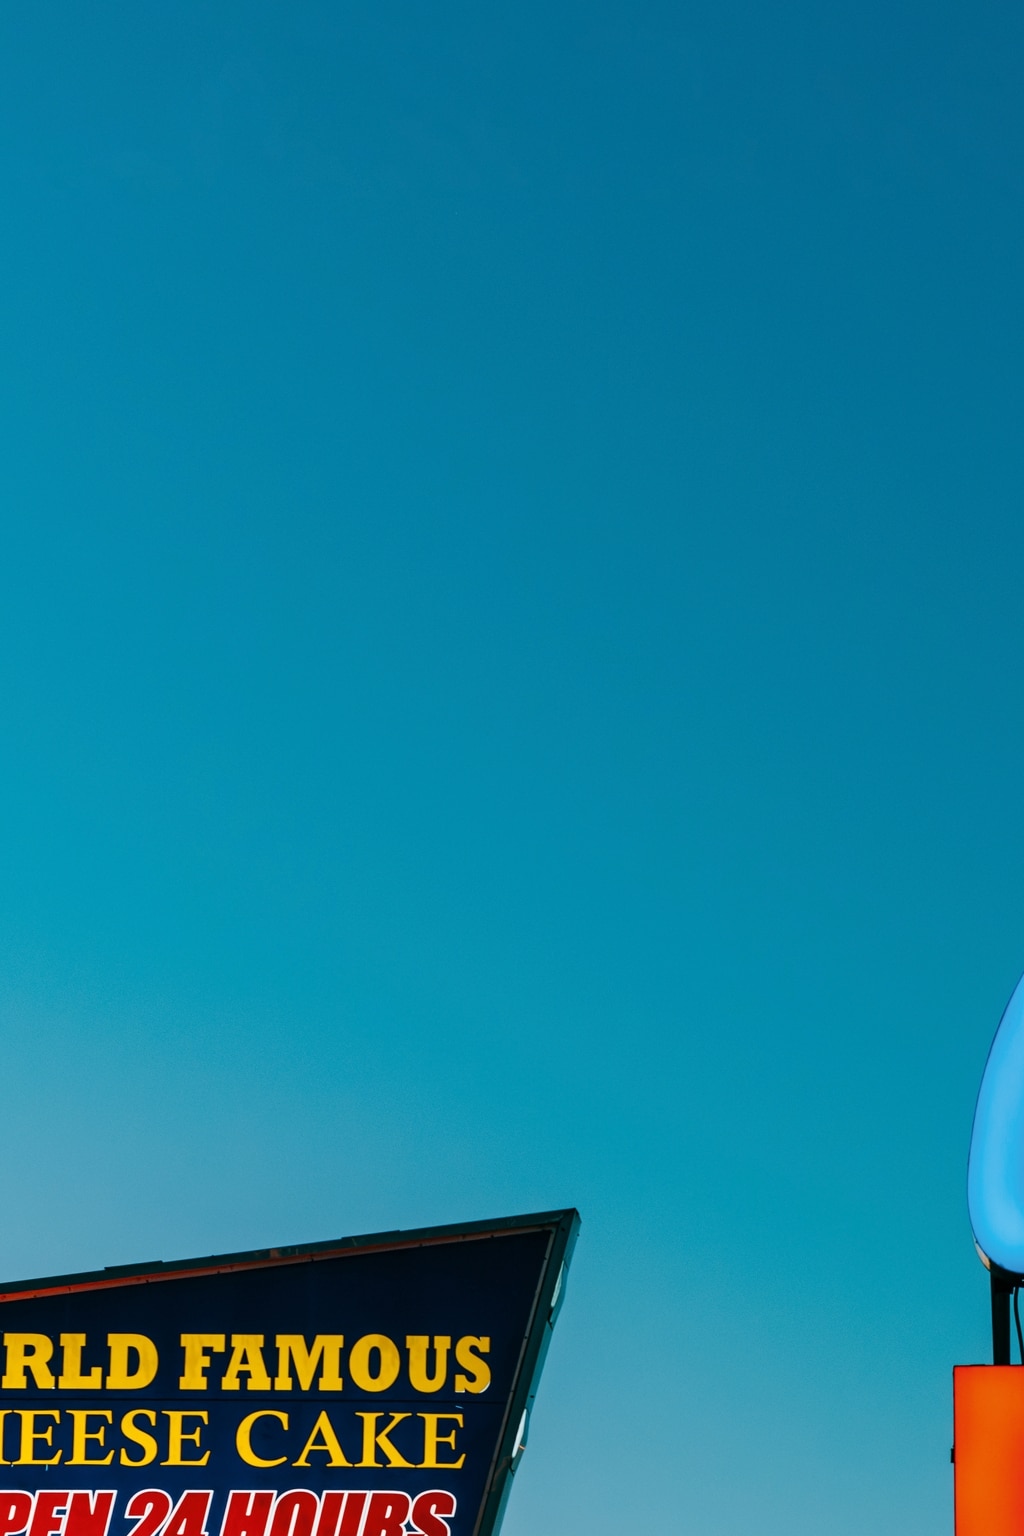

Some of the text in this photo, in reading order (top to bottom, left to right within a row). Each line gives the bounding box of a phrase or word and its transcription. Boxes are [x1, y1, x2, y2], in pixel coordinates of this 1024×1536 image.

[2, 1332, 491, 1394] RLD FAMOUS
[0, 1409, 466, 1469] EESE CAKE
